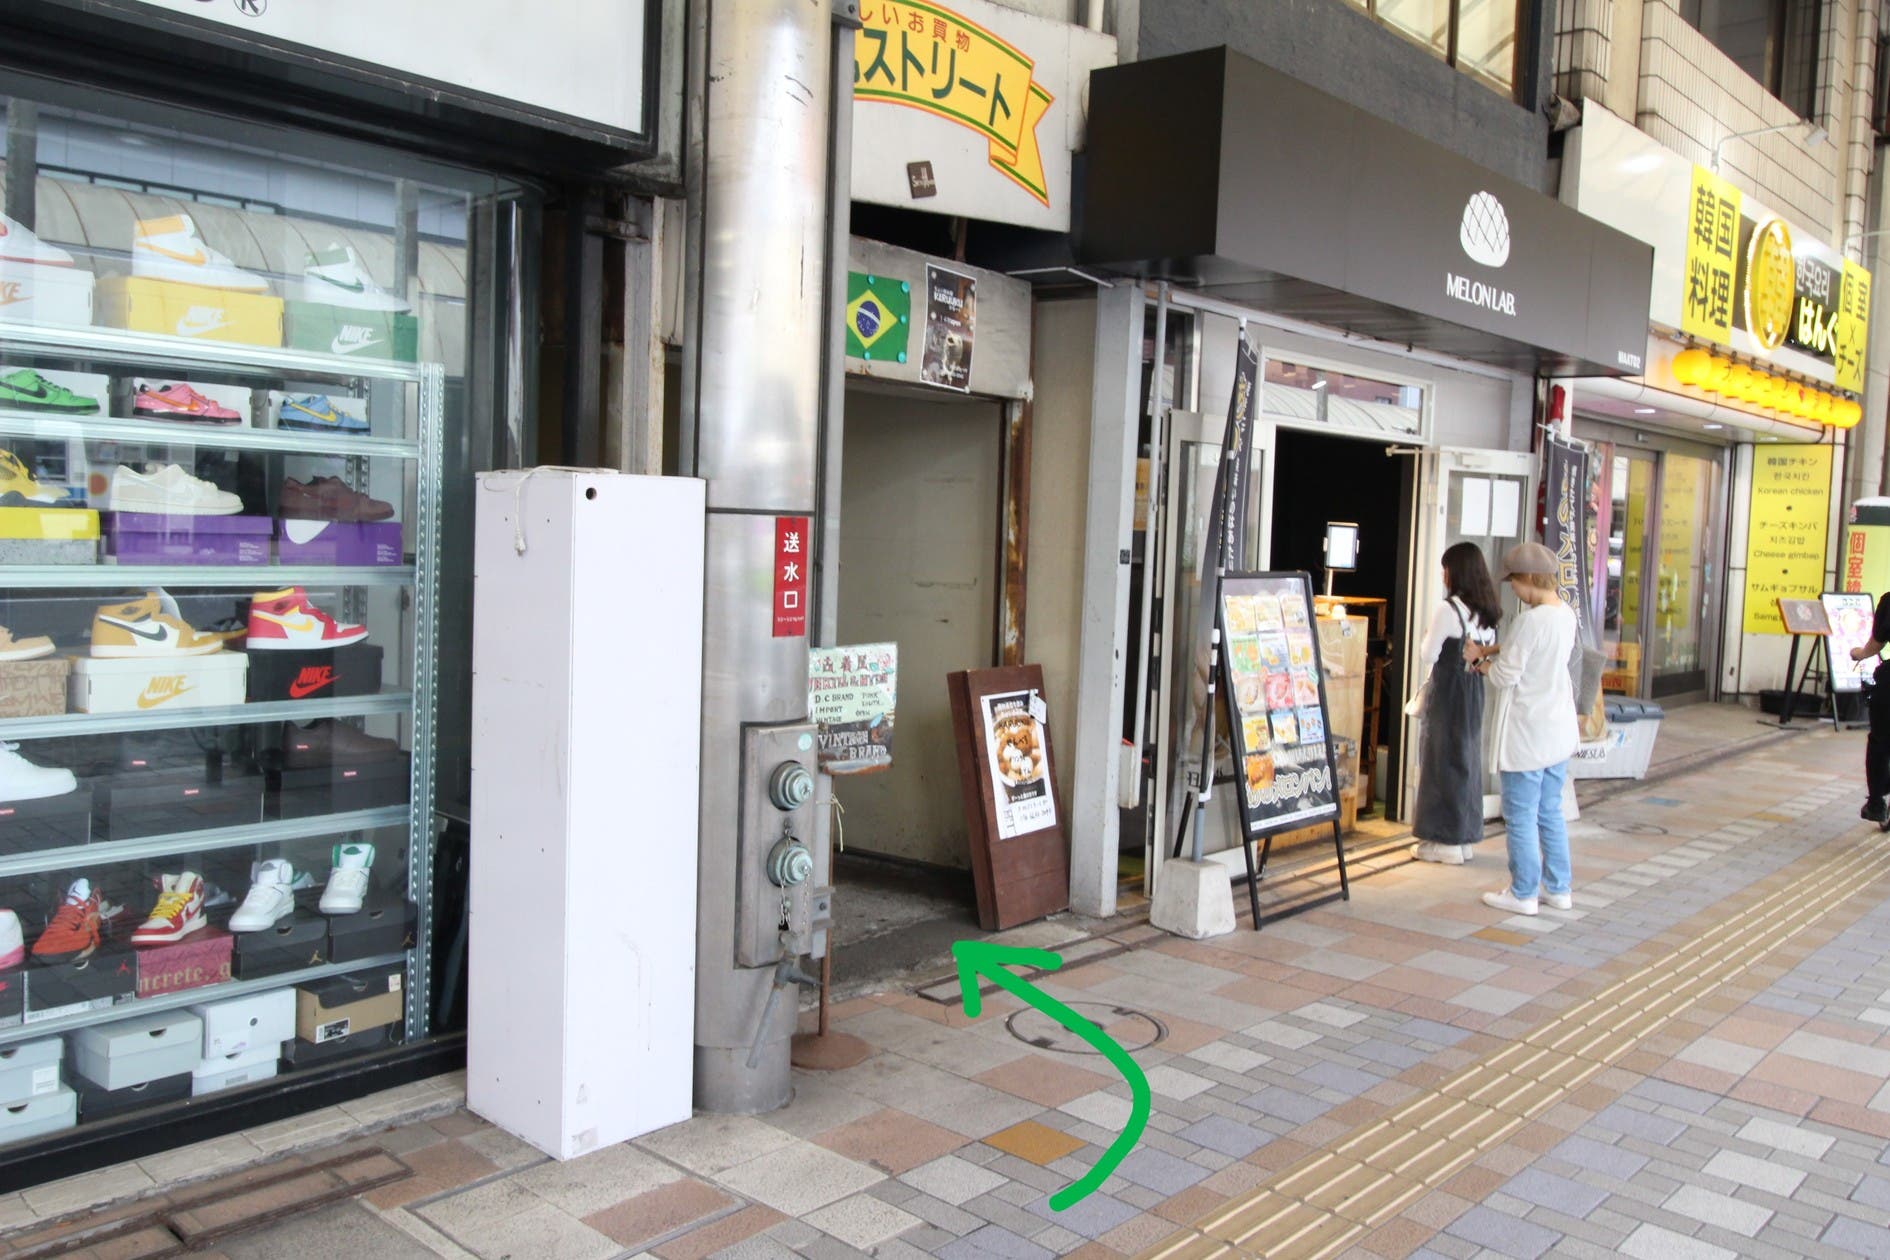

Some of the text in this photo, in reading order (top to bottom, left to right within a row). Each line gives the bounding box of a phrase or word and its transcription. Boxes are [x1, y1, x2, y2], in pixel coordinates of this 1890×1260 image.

[1693, 182, 1736, 262] 韓国
[1687, 256, 1731, 330] 料理
[1758, 487, 1824, 496] Korean chicken
[1753, 551, 1786, 559] Cheese
[783, 532, 800, 609] 送水口
[146, 675, 187, 695] NIKE
[299, 666, 333, 688] NIKE
